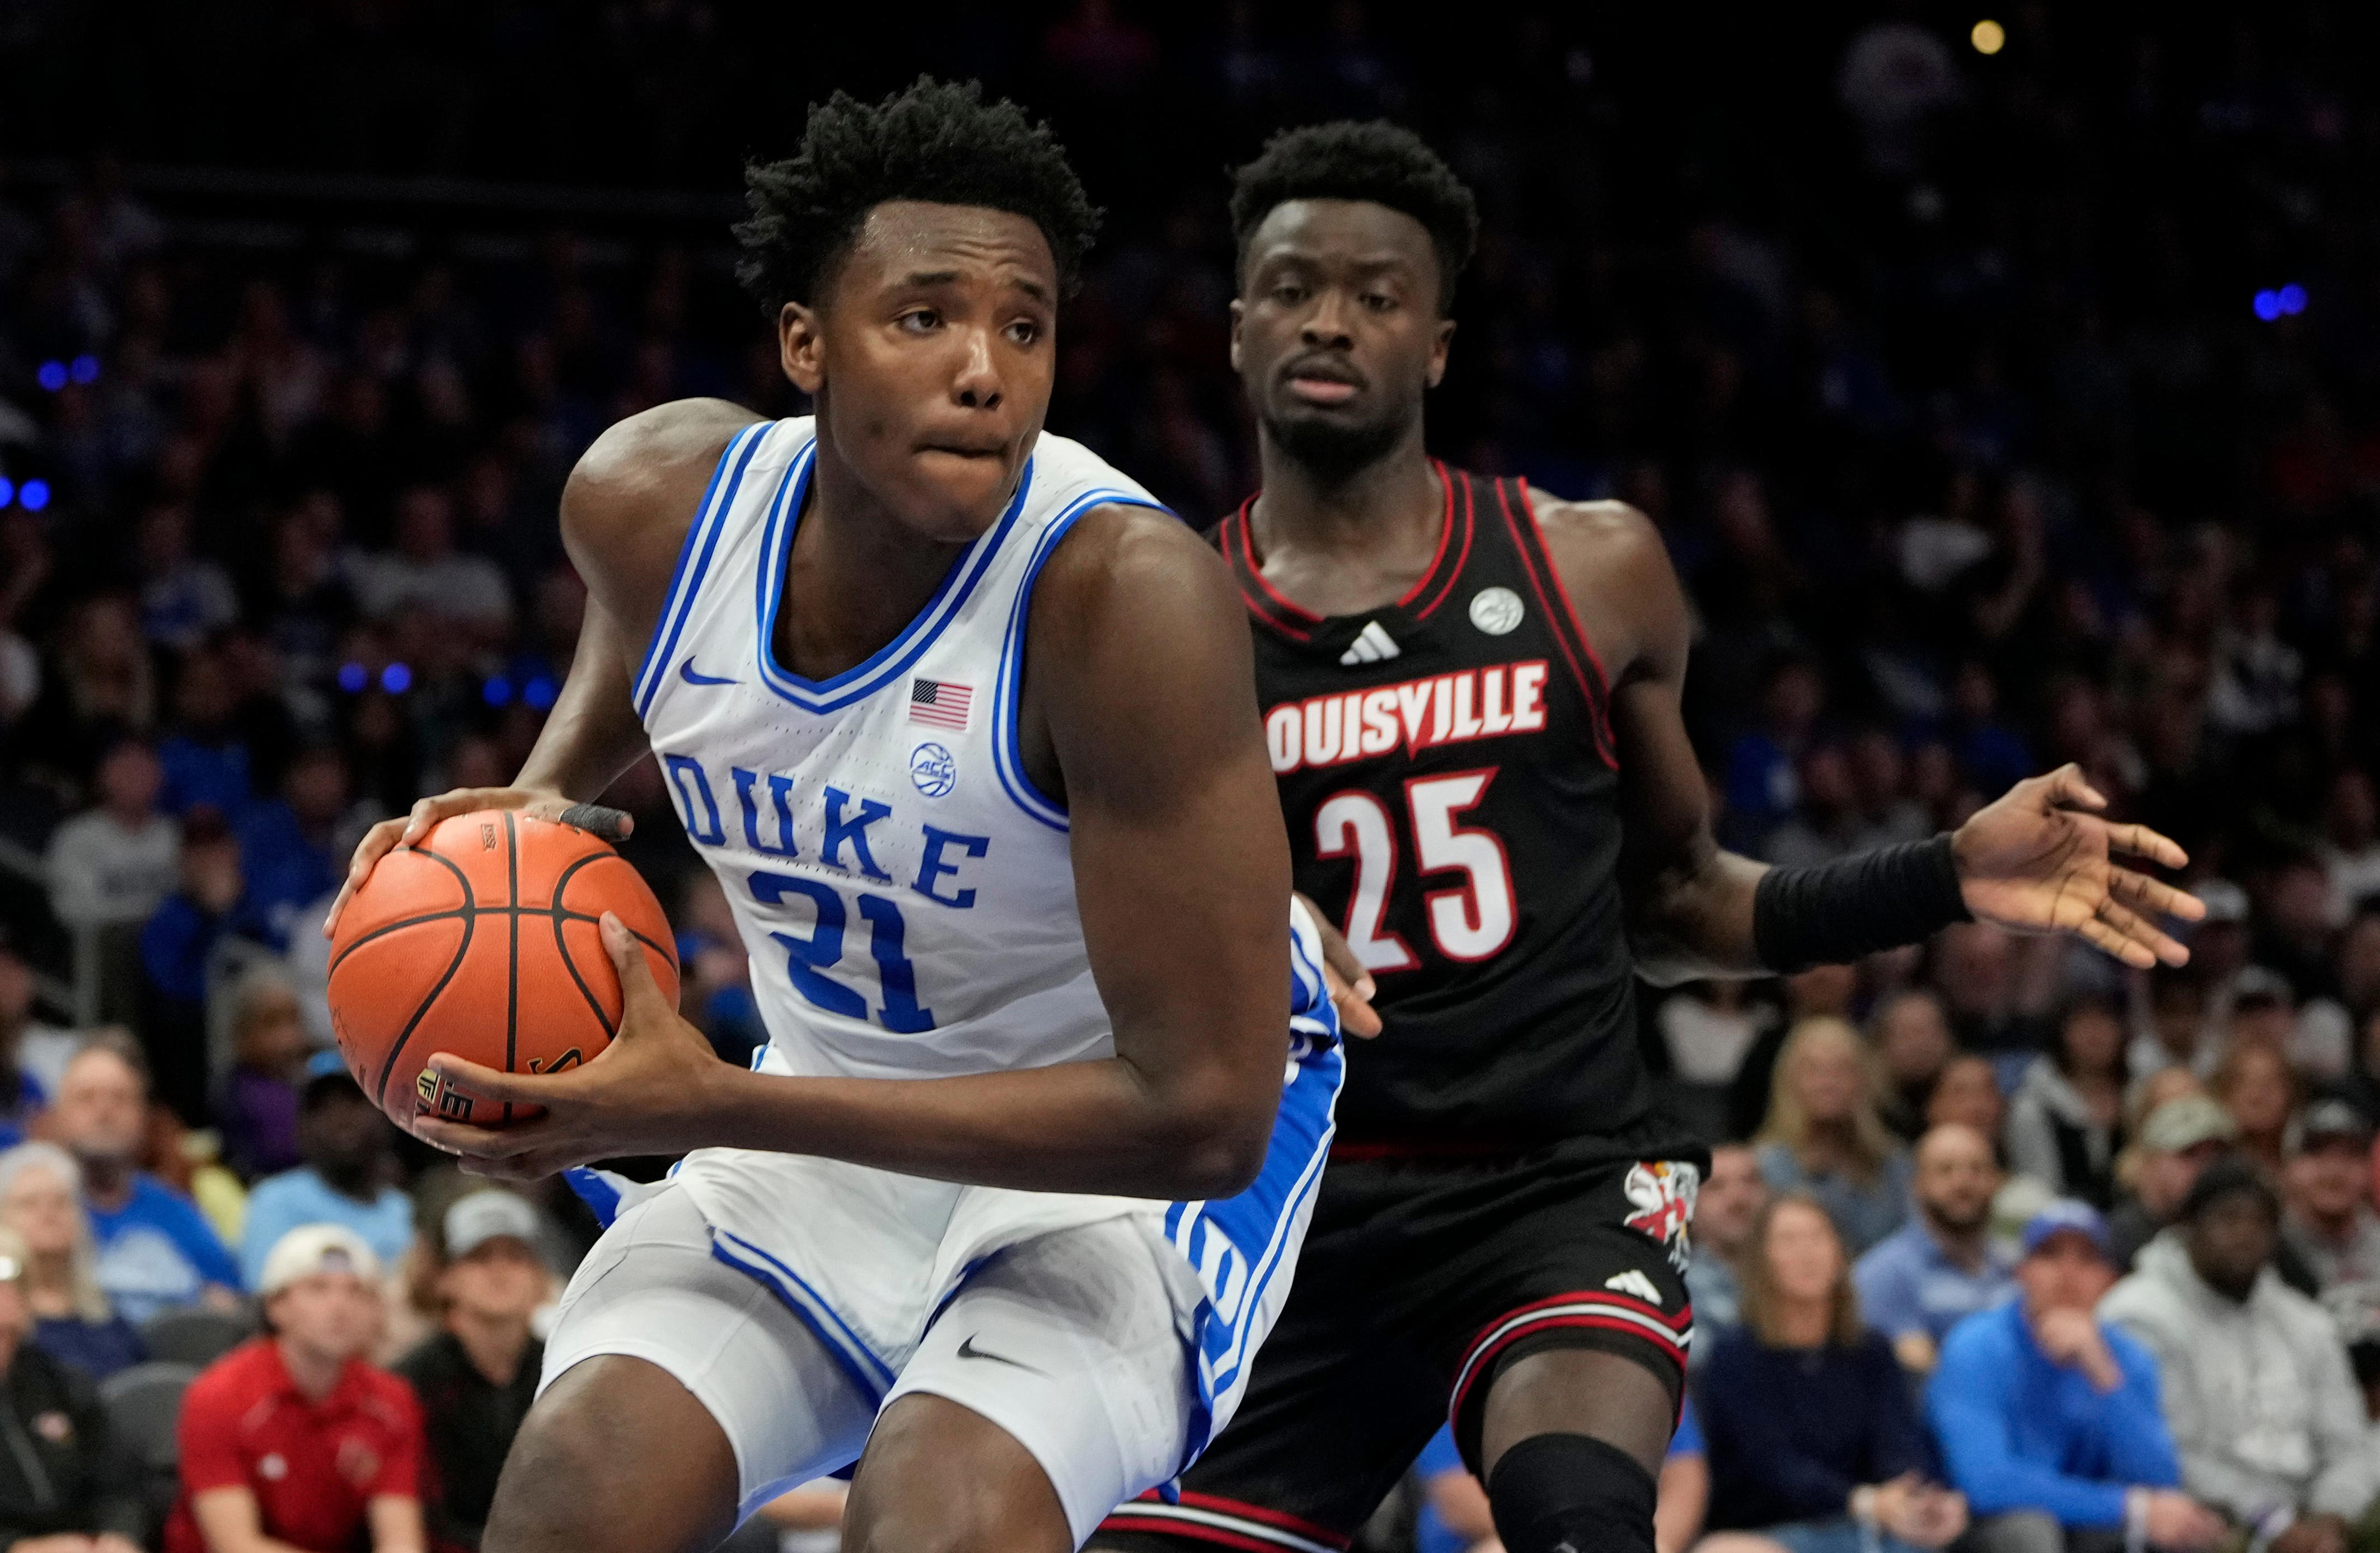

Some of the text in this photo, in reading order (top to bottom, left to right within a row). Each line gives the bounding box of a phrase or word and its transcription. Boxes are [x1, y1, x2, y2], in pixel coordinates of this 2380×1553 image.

[912, 761, 954, 779] ACC
[1263, 659, 1548, 775] OUISVILLE
[663, 753, 990, 909] DUKE
[1314, 766, 1519, 972] 25
[748, 870, 935, 1033] 21
